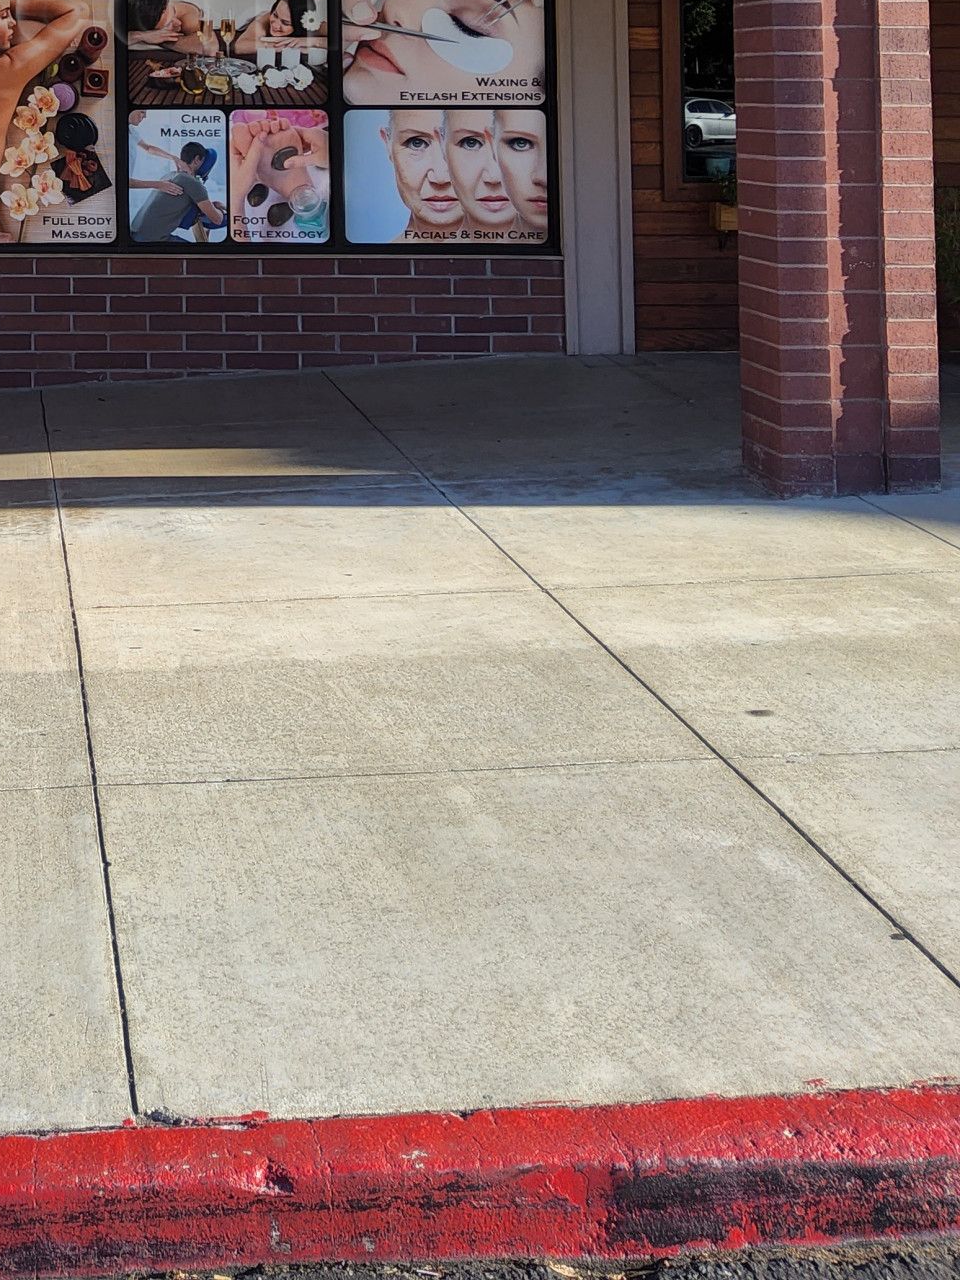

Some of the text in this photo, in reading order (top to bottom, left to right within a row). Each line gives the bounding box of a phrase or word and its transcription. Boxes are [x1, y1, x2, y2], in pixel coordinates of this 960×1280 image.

[476, 77, 541, 87] WAXING &
[400, 91, 542, 101] EYELASH EXTENSIONS
[181, 114, 221, 123] CHAIR
[160, 127, 221, 137] MASSAGE
[42, 216, 112, 225] FULL BODY
[233, 216, 266, 224] FOOT
[51, 230, 113, 239] MASSAGE
[233, 229, 324, 238] REFLEXOLOGY
[404, 230, 544, 240] FACIALS & SKIN CARE
